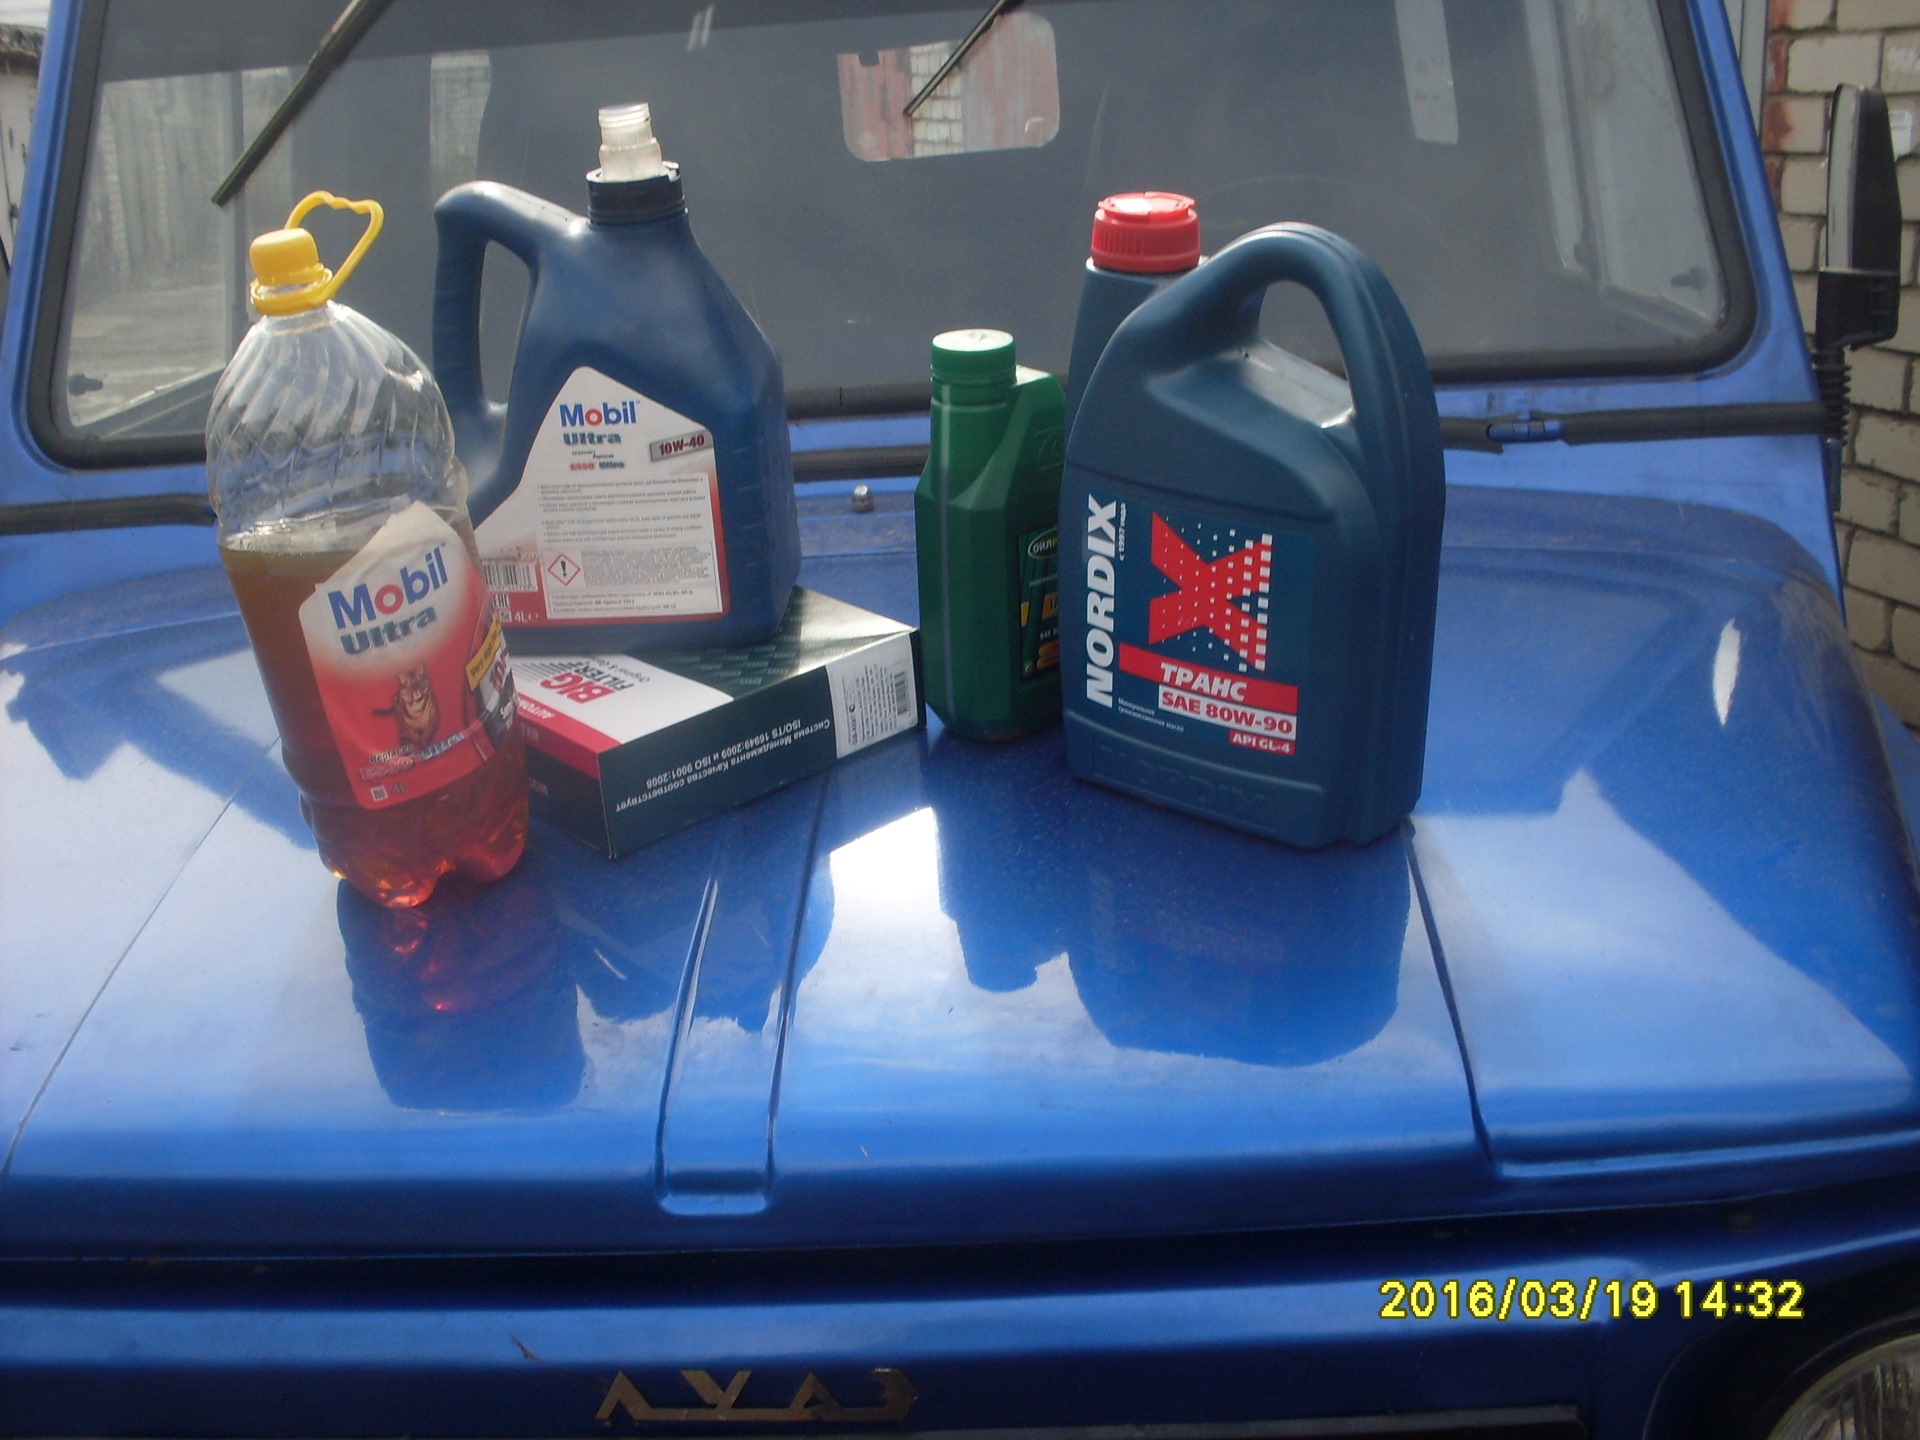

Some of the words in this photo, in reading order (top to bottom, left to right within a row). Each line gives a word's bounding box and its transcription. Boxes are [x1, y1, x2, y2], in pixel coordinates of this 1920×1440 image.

[559, 401, 637, 428] Mobil
[562, 431, 622, 446] Ultra
[658, 434, 705, 456] 10W-40
[328, 547, 449, 629] Mobil
[1086, 493, 1117, 708] NORDIX
[340, 606, 437, 655] Ultra
[540, 671, 616, 704] BIG
[573, 664, 634, 691] FILTER
[1160, 661, 1248, 702] ТРАНС
[1161, 690, 1201, 714] SAE
[1205, 697, 1294, 734] 80W-90
[771, 718, 801, 739] ISO/TS
[793, 718, 831, 740] Система
[721, 732, 770, 759] 16949:2009
[730, 735, 792, 768] Менеджмента
[1232, 732, 1257, 747] API
[1258, 738, 1291, 754] GL-4
[694, 756, 712, 769] ISO
[713, 753, 720, 761] и
[646, 762, 693, 789] 9001:2008
[686, 761, 729, 785] Качества
[616, 778, 685, 812] соответствует
